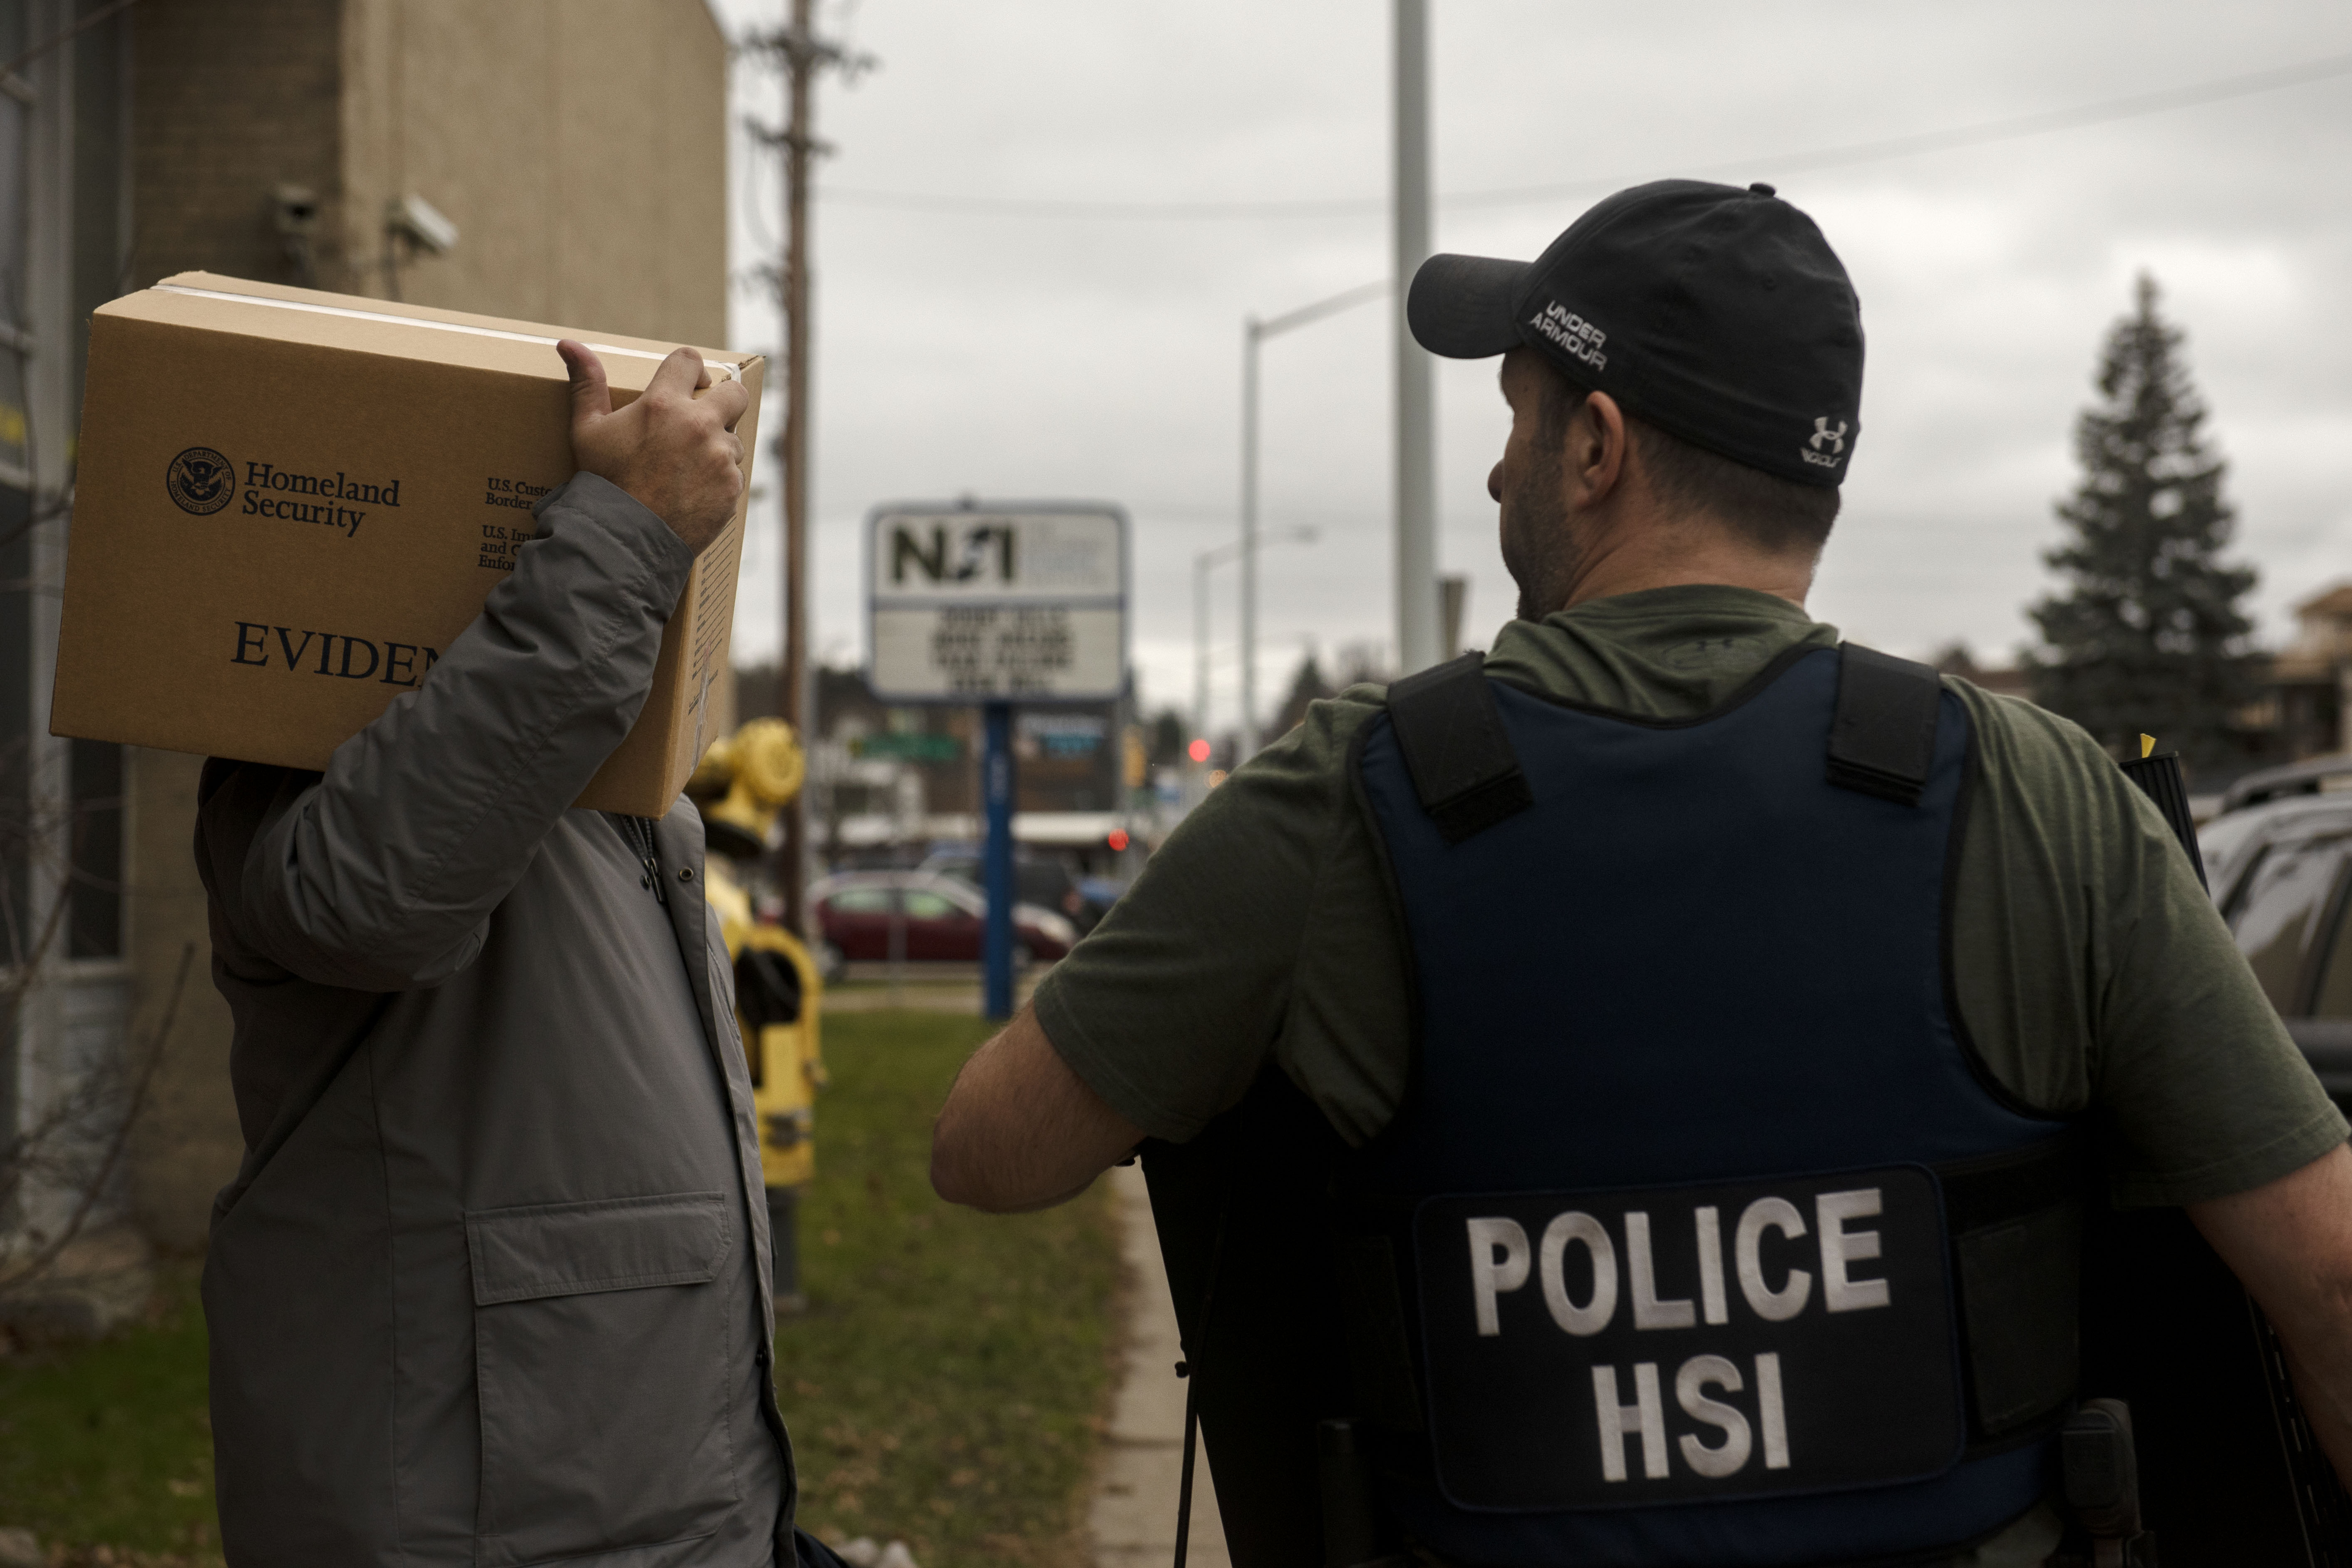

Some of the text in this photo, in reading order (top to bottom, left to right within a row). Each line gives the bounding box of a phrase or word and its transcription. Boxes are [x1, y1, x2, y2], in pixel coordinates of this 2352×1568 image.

[1530, 312, 1607, 371] ARMOUR
[1546, 300, 1607, 349] UNDER
[184, 451, 230, 469] DEPARTMENT
[225, 471, 231, 480] OF
[171, 481, 231, 511] HOMELAND SECURITY
[245, 462, 400, 507] Homeland
[485, 492, 532, 510] Border
[488, 478, 512, 492] U.S.
[243, 490, 366, 538] Security
[481, 542, 506, 554] and
[482, 525, 535, 541] U.S. Im
[1466, 1188, 1891, 1337] POLICE
[1591, 1352, 1790, 1482] HSI
